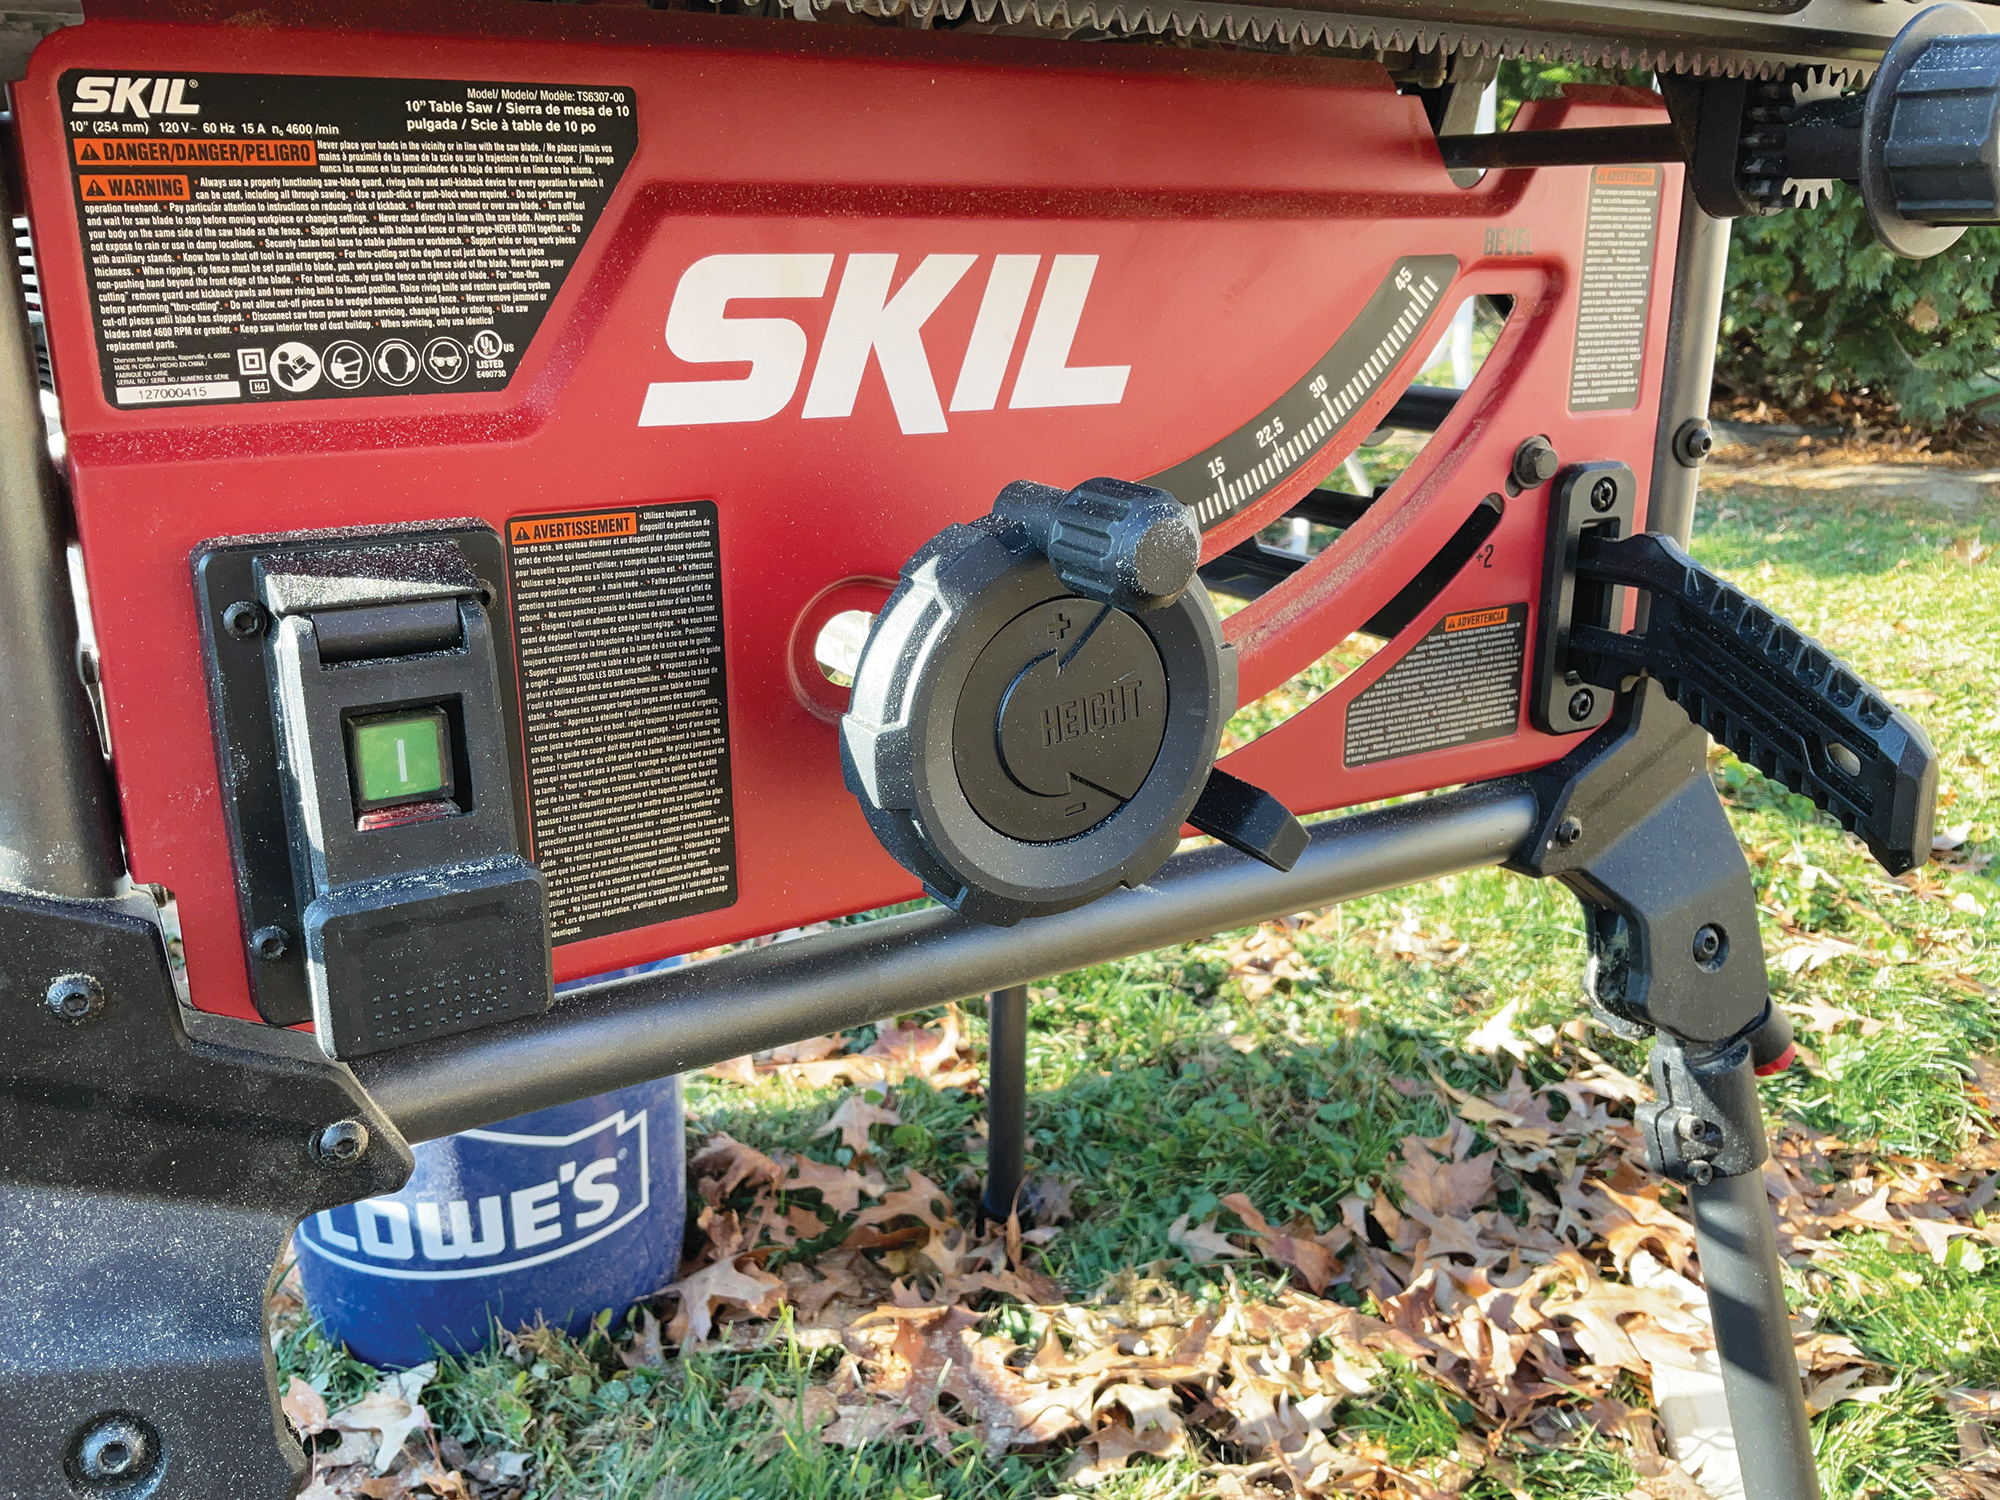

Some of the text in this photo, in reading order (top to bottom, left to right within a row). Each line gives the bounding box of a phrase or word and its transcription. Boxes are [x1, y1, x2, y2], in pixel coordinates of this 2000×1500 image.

[466, 87, 624, 103] Model/ Modelo/ Modèle: TS6307-00
[427, 99, 463, 113] Table
[465, 100, 493, 113] Saw
[505, 101, 542, 114] Sierra
[544, 102, 560, 115] de
[563, 105, 595, 116] mesa
[597, 104, 613, 116] de
[615, 104, 629, 116] 10
[92, 120, 119, 134] (254
[121, 120, 149, 135] mm)
[158, 121, 179, 133] 120
[202, 122, 217, 133] 60
[219, 122, 235, 133] Hz
[240, 122, 254, 134] 15
[256, 122, 266, 134] A
[285, 122, 312, 134] 4600
[314, 123, 339, 134] /min
[406, 118, 457, 132] pulgada
[470, 118, 498, 130] Scie
[500, 119, 509, 131] à
[511, 119, 543, 131] table
[545, 120, 561, 132] de
[563, 120, 578, 132] 10
[580, 123, 596, 134] po
[104, 142, 310, 163] DANGER/DANGER/PELIGRO
[316, 139, 612, 154] Never place your hands in the vicinity or in line with the saw blade. / Ne placez jamais vos
[317, 150, 614, 166] mains à proximité de la lame de la scie ou sur la trajectoire du trait de coupe. / No ponga
[319, 163, 594, 175] nunca las manos en las proximidades de la hoja de sierra ni en línea con la misma.
[108, 178, 183, 196] WARNING
[1484, 226, 1534, 256] BEVEL
[1394, 266, 1412, 291] 45
[638, 254, 1131, 435] SKIL
[476, 360, 504, 369] LISTED
[476, 370, 507, 379] E490730
[138, 386, 207, 400] 127000415
[254, 382, 266, 391] H4
[1309, 374, 1328, 399] 30
[1256, 416, 1285, 448] 22.5
[1207, 456, 1226, 479] 15
[642, 511, 664, 520] Utilisez
[664, 509, 688, 518] toujours
[533, 517, 630, 539] AVERTISSEMENT
[639, 521, 665, 532] dispositif
[674, 518, 702, 529] protection
[512, 546, 529, 554] lame
[538, 543, 554, 552] scie,
[563, 540, 588, 549] couteau
[588, 538, 612, 547] diviseur
[628, 533, 654, 544] dispositif
[663, 530, 692, 541] protection
[692, 529, 710, 538] contre
[1457, 610, 1504, 628] ADVERTENCIA
[1040, 680, 1142, 748] HEIGHT
